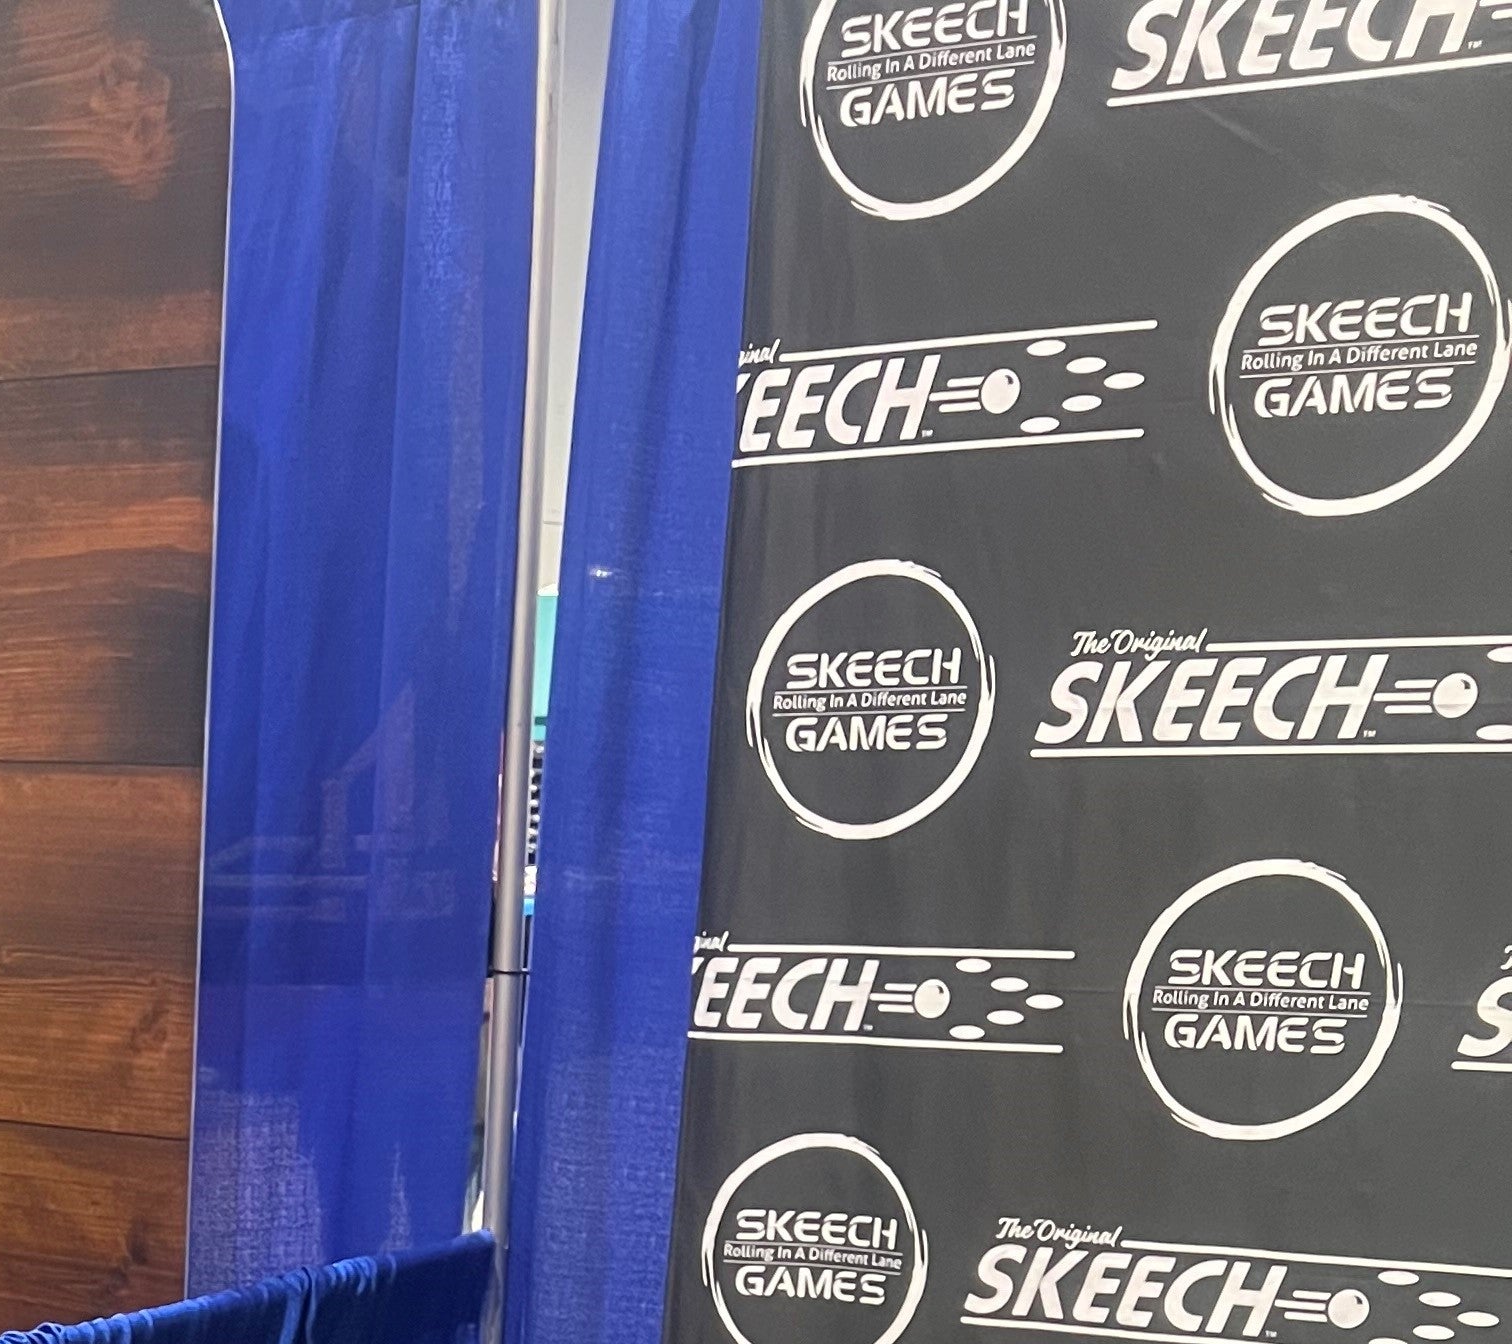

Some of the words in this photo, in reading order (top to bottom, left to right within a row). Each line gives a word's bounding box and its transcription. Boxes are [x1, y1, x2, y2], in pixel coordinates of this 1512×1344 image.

[841, 0, 1030, 58] SKEECH
[827, 60, 882, 82] Rolling
[886, 58, 900, 74] In
[904, 57, 915, 72] A
[919, 47, 992, 70] Different
[996, 41, 1036, 60] Lane
[840, 68, 1016, 127] GAMES
[1257, 292, 1473, 347] SKEECH
[1241, 352, 1303, 371] Rolling
[1307, 350, 1324, 366] In
[1328, 349, 1341, 365] A
[1346, 345, 1428, 364] Different
[1433, 340, 1478, 358] Lane
[736, 354, 942, 453] EECH
[1254, 367, 1454, 418] GAMES
[1070, 630, 1112, 656] The
[1109, 628, 1208, 661] Original
[786, 647, 962, 690] SKEECH
[773, 695, 827, 712] Rolling
[829, 694, 844, 708] In
[846, 693, 858, 707] A
[861, 692, 927, 707] Different
[930, 691, 967, 706] Lane
[1034, 653, 1390, 745] SKEECH
[785, 713, 949, 752] GAMES
[1167, 949, 1366, 990] SKEECH
[691, 957, 881, 1031] EECH
[1152, 990, 1210, 1009] Rolling
[1213, 990, 1230, 1006] In
[1232, 991, 1246, 1006] A
[1249, 992, 1326, 1010] Different
[1328, 994, 1370, 1011] Lane
[1163, 1013, 1348, 1054] GAMES
[736, 1209, 898, 1250] SKEECH
[995, 1216, 1034, 1240] The
[1032, 1218, 1123, 1250] Original
[723, 1243, 774, 1262] Rolling
[777, 1246, 791, 1260] In
[794, 1247, 806, 1260] A
[809, 1247, 869, 1266] Different
[872, 1253, 903, 1270] Lane
[735, 1265, 887, 1306] GAMES
[964, 1243, 1288, 1338] SKEECH
